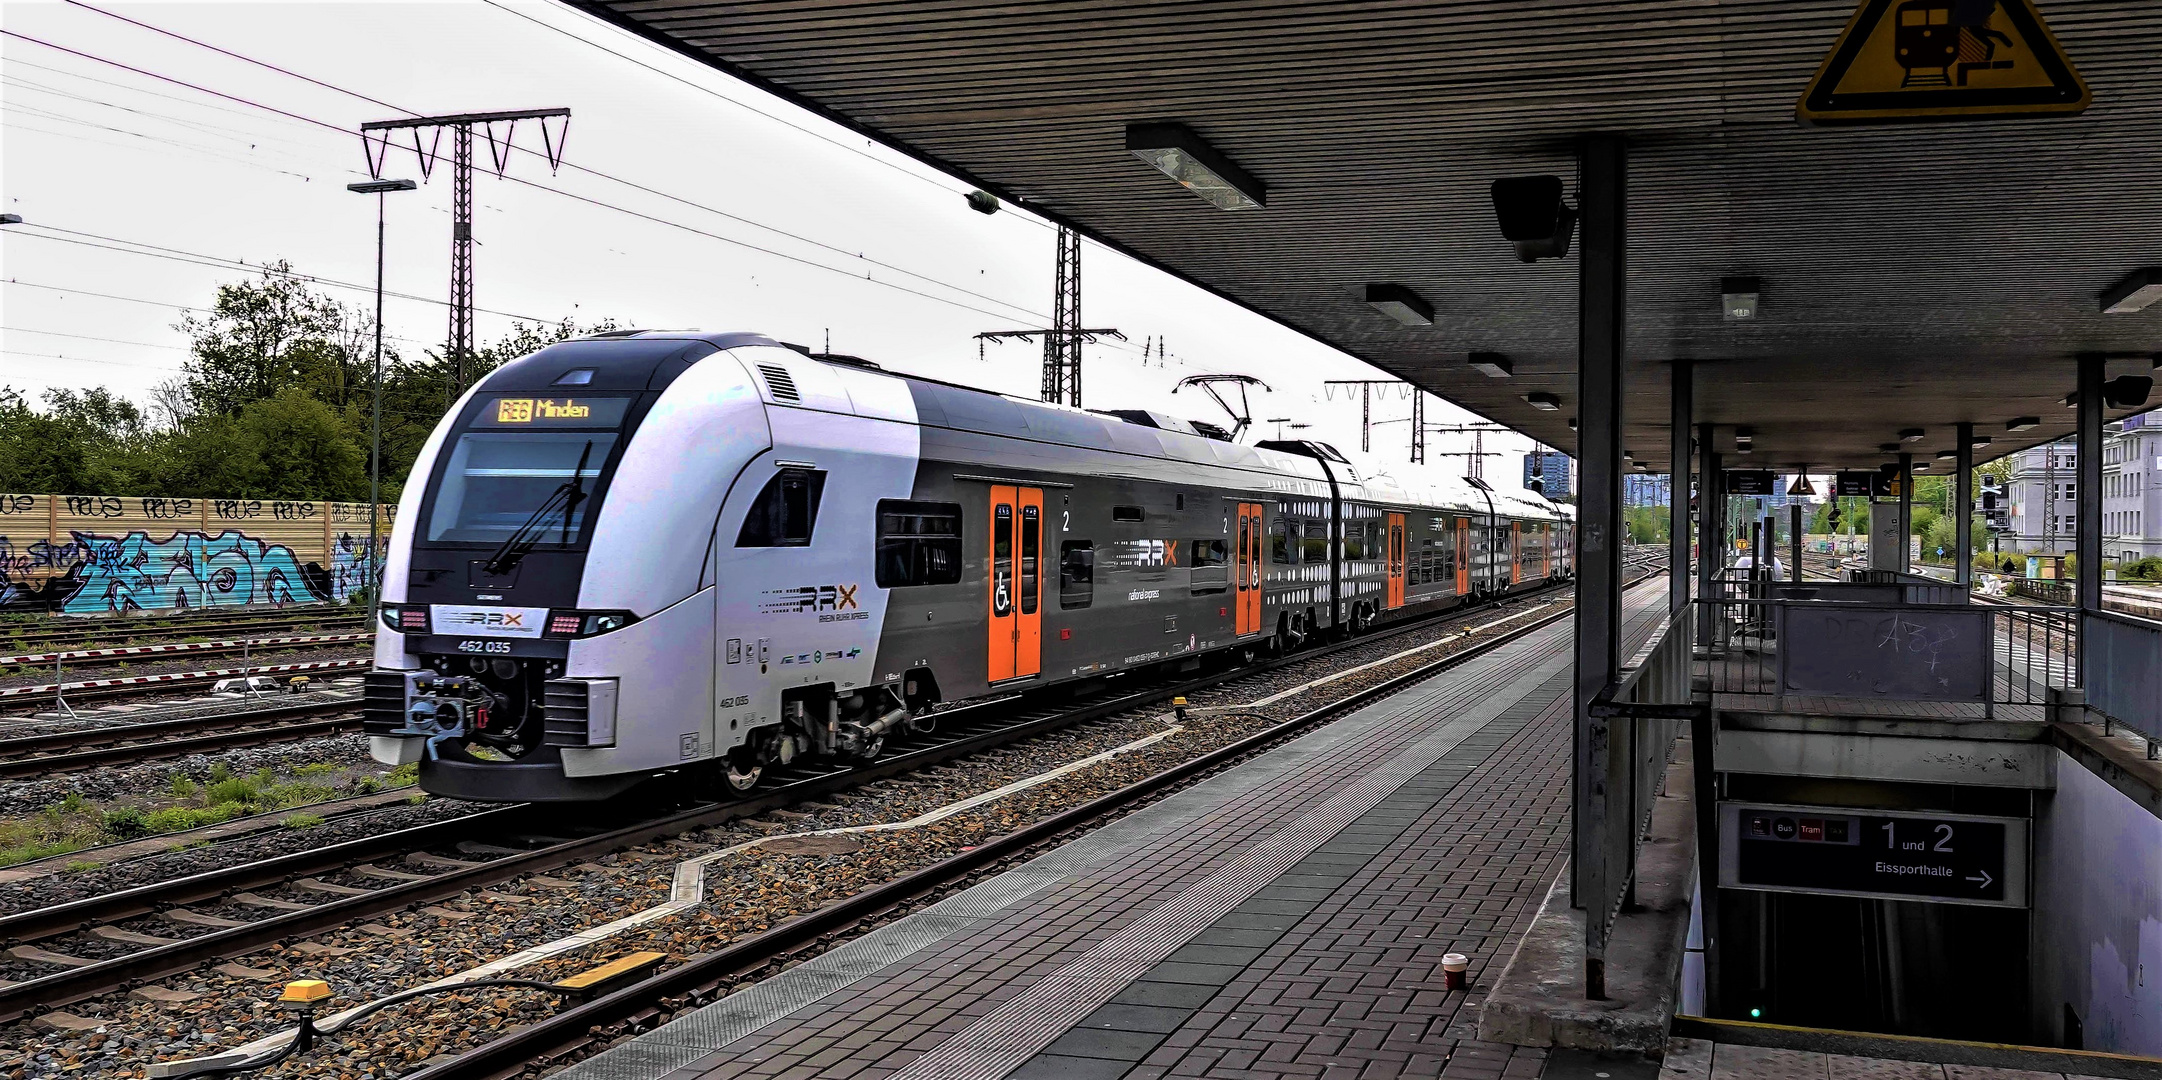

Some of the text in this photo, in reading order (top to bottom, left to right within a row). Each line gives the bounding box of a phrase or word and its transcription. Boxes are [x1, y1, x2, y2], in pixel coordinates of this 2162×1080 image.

[502, 399, 590, 420] RE6 Minden
[1063, 511, 1070, 532] 2
[1223, 518, 1228, 533] 2
[1138, 539, 1178, 567] RRX
[800, 583, 858, 613] RRX
[1128, 588, 1160, 602] national express
[458, 640, 511, 654] 462 035
[720, 695, 749, 708] 462 035
[1777, 824, 1793, 833] Bus
[1801, 825, 1821, 834] Tram
[1882, 821, 1895, 849] 1
[1902, 839, 1925, 851] und
[1933, 824, 1954, 853] 2
[1875, 861, 1953, 877] Eissporthalle
